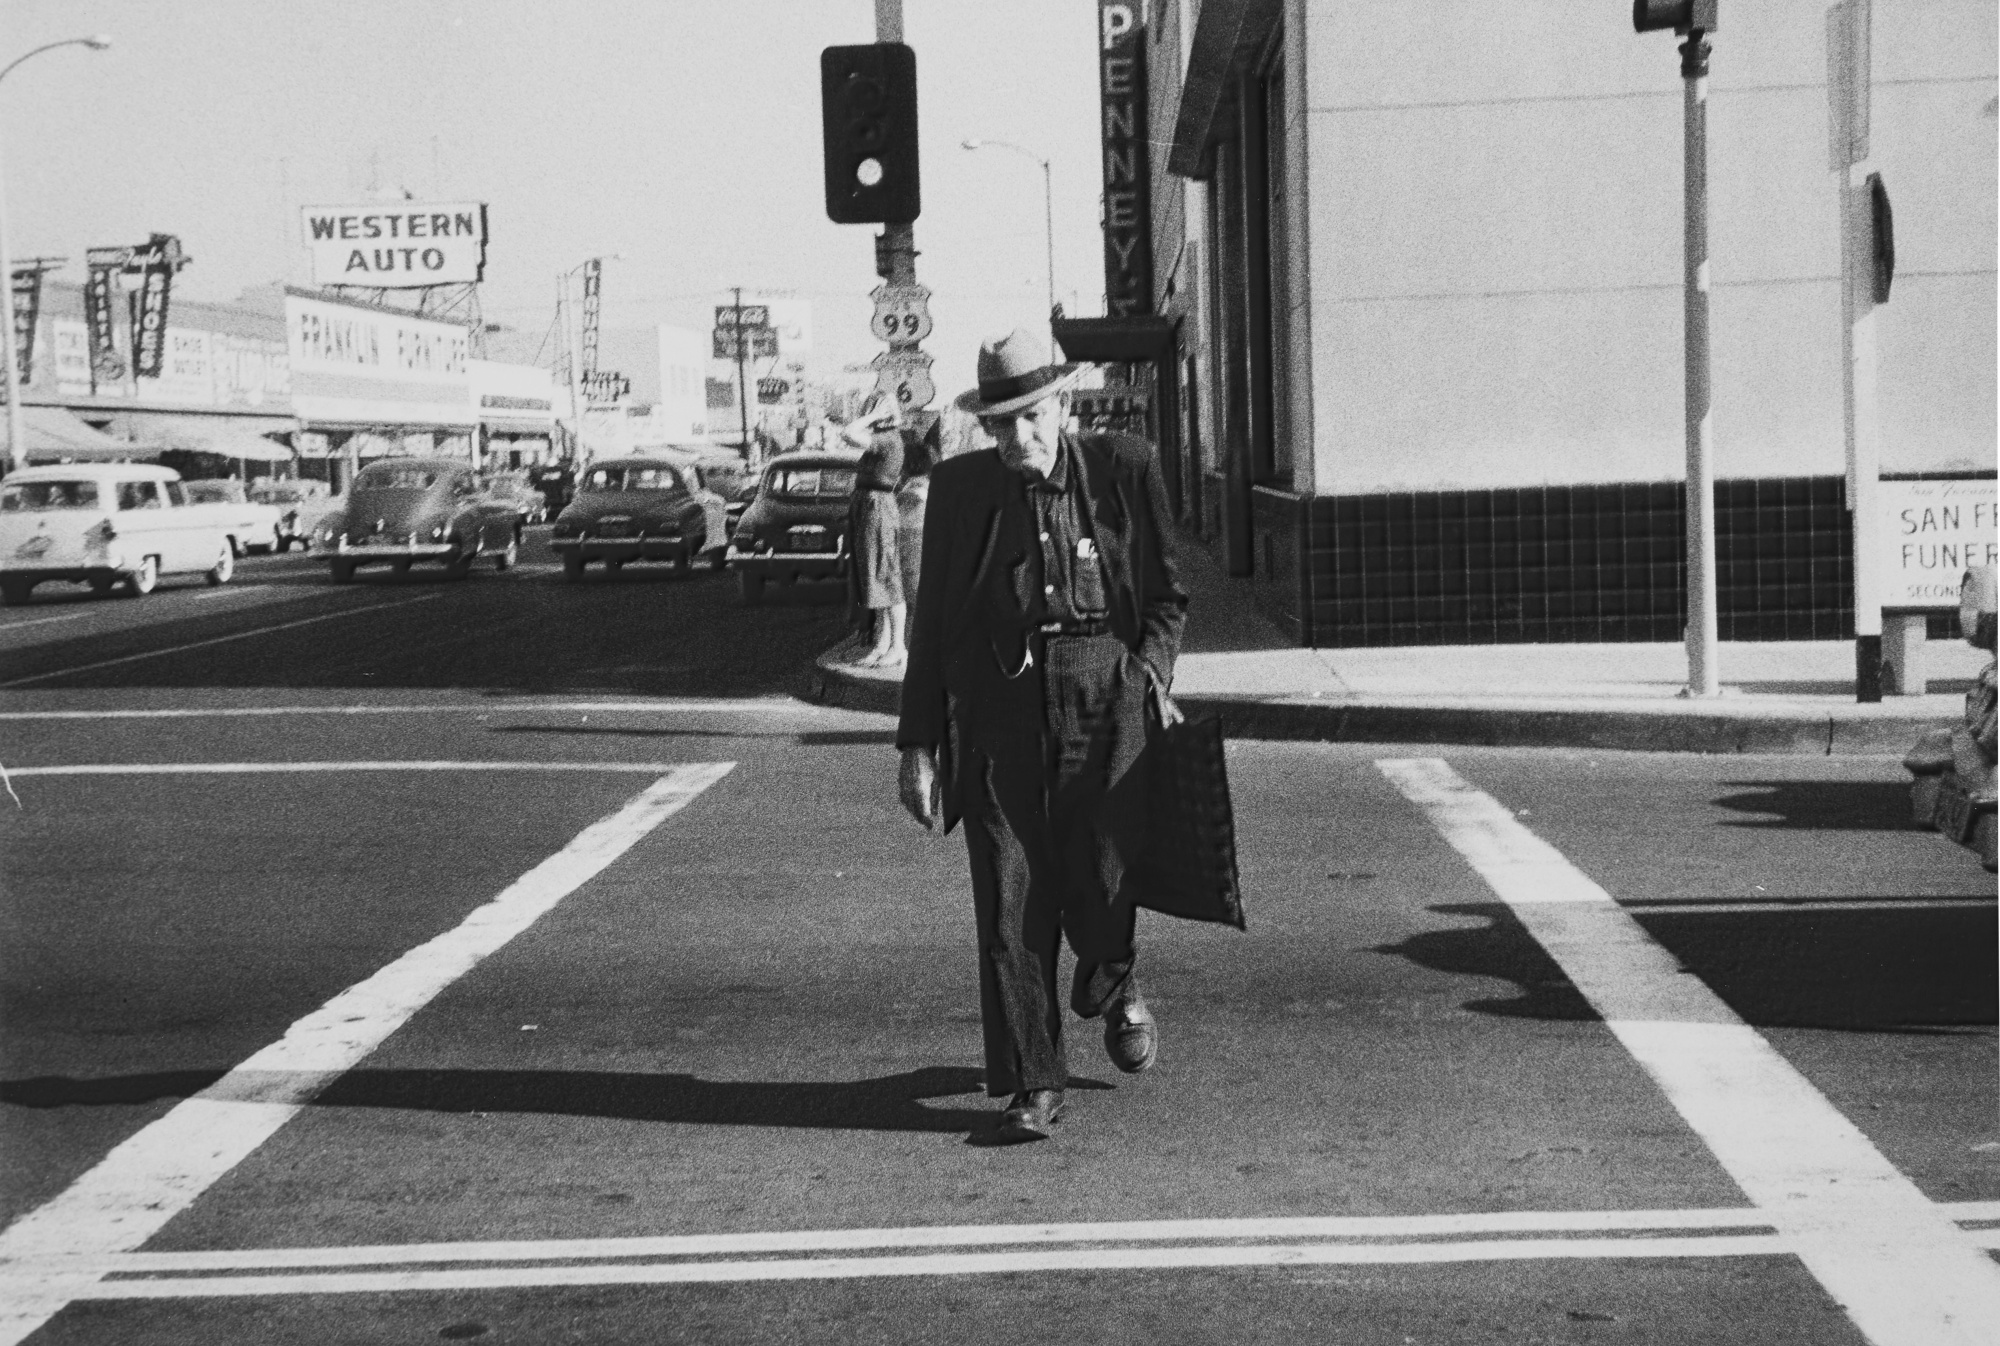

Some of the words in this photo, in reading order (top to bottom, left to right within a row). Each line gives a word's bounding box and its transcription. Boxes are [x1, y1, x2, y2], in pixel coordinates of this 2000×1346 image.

[309, 212, 474, 240] WESTERN
[345, 248, 445, 272] AUTO
[140, 273, 166, 370] SHOES
[883, 313, 919, 336] 99
[897, 381, 913, 403] 6
[1901, 505, 1959, 534] SAN
[1974, 502, 1997, 528] F
